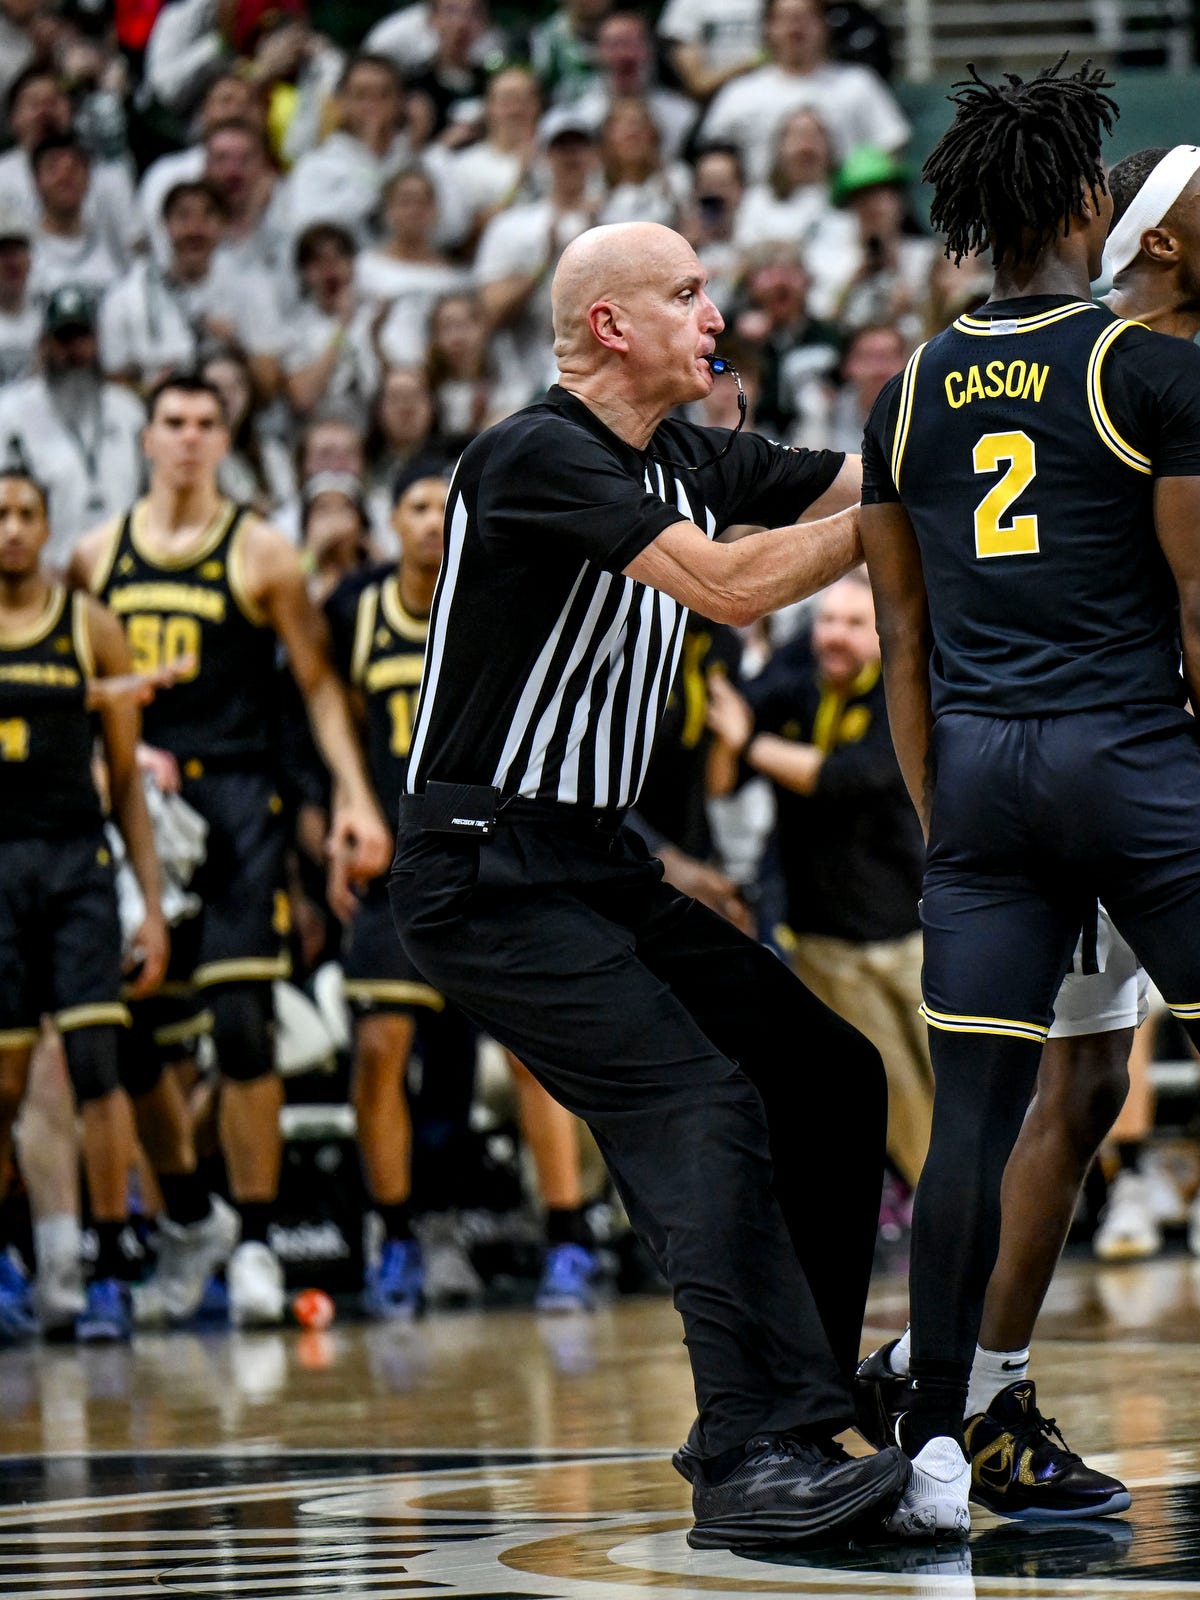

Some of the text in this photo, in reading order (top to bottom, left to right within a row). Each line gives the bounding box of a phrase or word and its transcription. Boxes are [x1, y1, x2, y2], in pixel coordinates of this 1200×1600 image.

[944, 360, 1050, 409] CASON
[972, 430, 1040, 559] 2
[129, 614, 201, 684] 50
